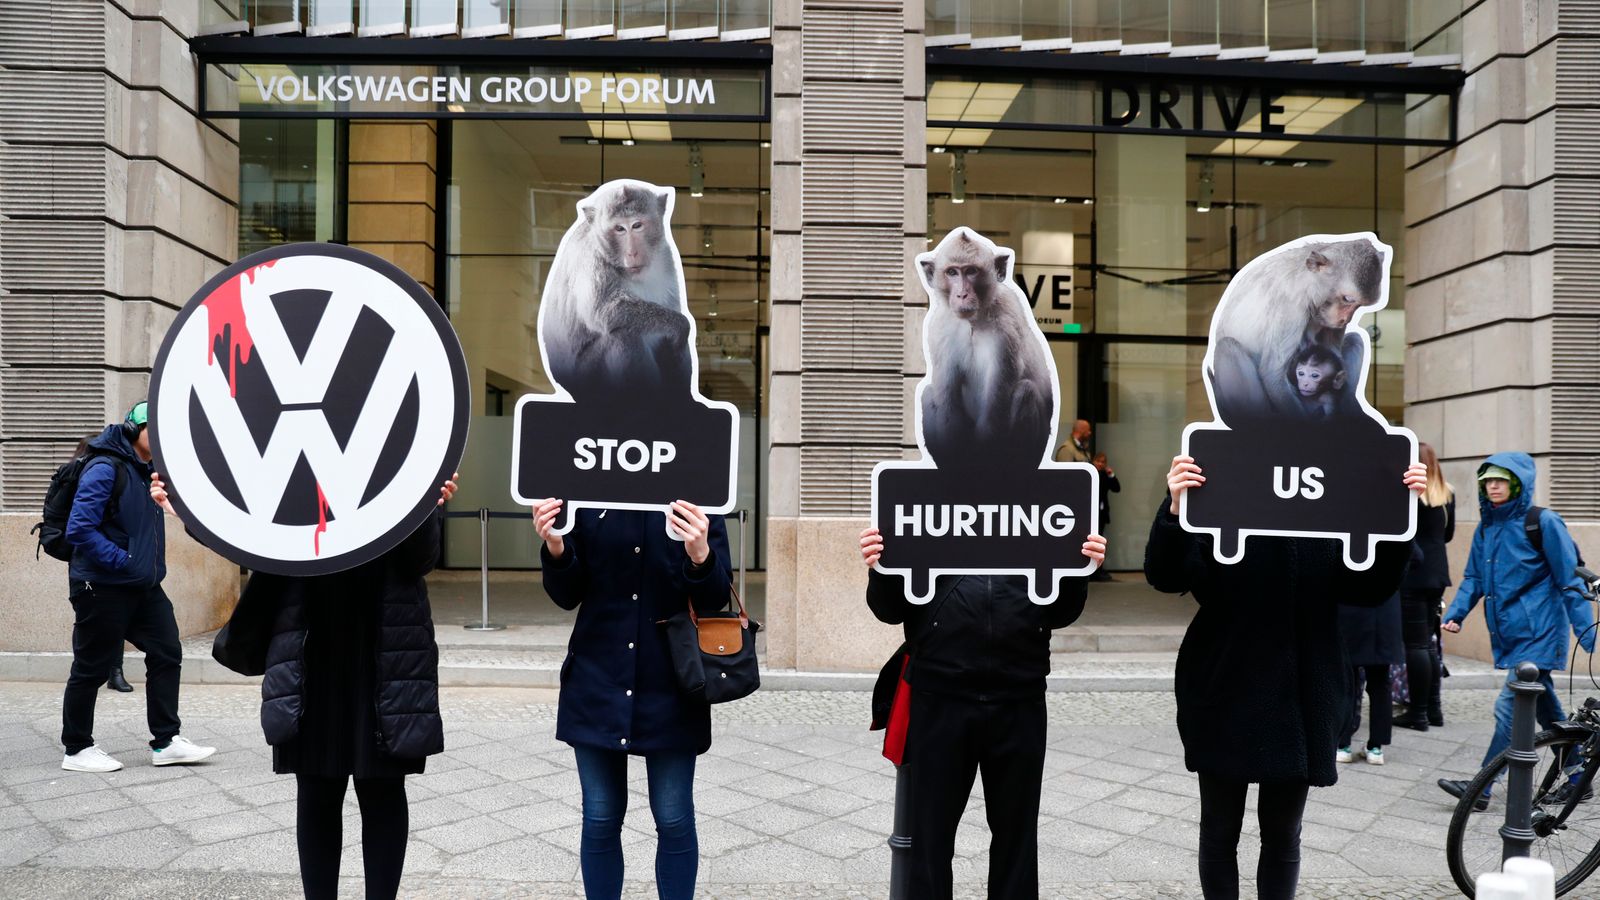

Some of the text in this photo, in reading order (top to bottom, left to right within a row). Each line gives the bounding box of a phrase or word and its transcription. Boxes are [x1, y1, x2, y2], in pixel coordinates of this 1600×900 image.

[255, 75, 716, 104] VOLKSWAGEN GROUP FORUM
[1102, 82, 1286, 134] DRIVE
[573, 437, 677, 473] STOP
[1273, 466, 1325, 500] US
[894, 503, 1076, 537] HURTING
